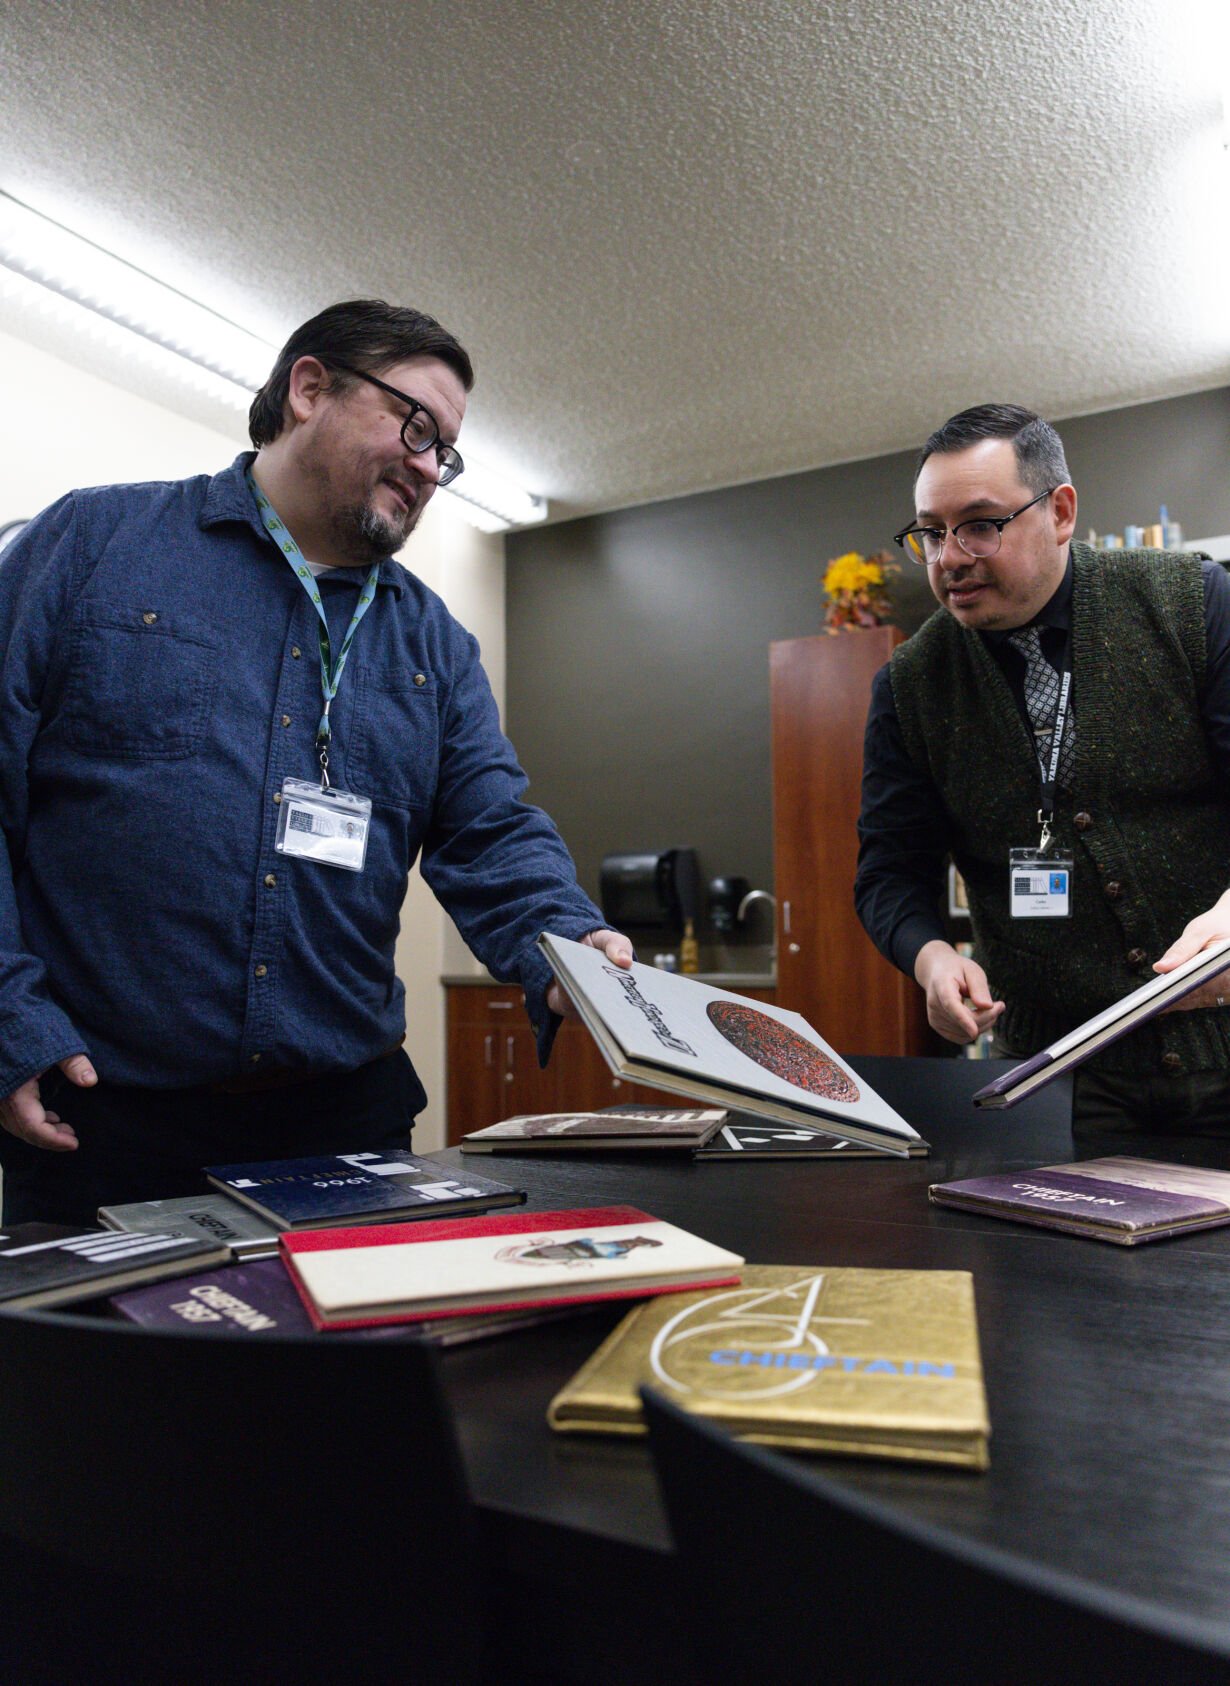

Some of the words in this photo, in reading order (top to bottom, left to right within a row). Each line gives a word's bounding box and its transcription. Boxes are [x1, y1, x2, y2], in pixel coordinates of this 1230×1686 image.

[1053, 715, 1064, 747] VALLEY
[312, 1176, 372, 1189] 1966
[1012, 1184, 1125, 1206] CHIEFTAIN
[708, 1349, 956, 1379] CHIEFTAIN
